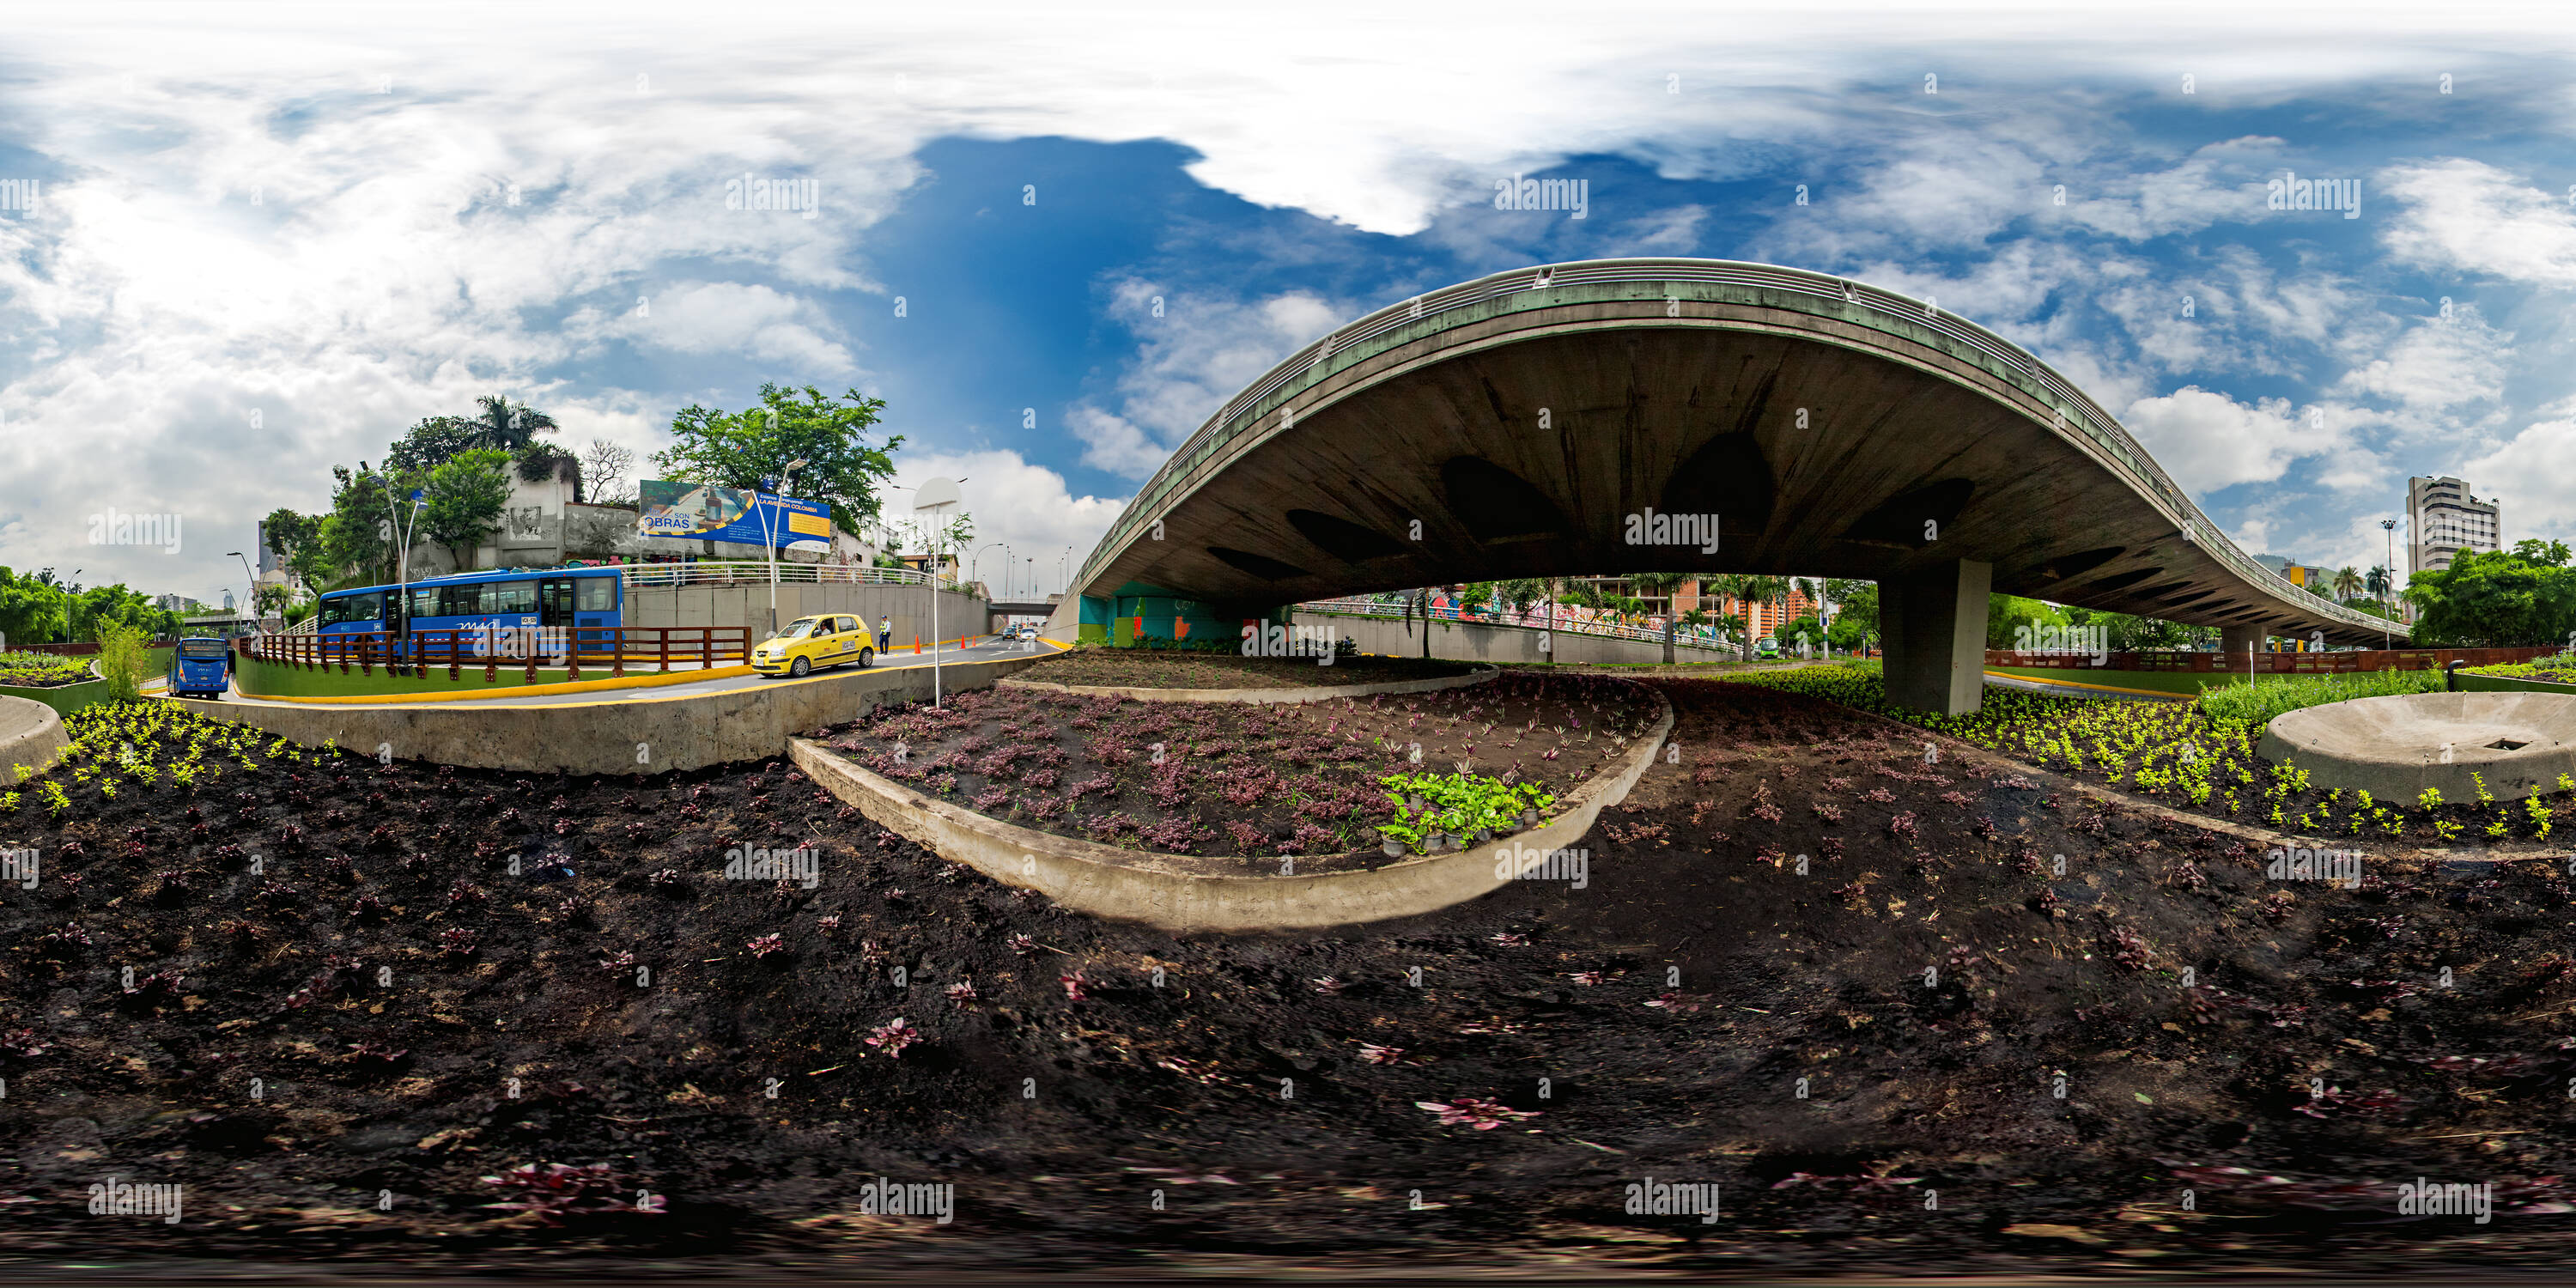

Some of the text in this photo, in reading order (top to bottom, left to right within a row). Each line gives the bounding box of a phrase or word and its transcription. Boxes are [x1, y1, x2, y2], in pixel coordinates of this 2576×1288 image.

[767, 500, 790, 508] AVEIDA
[791, 504, 817, 513] COLOMBIA
[645, 516, 690, 529] OBRAS
